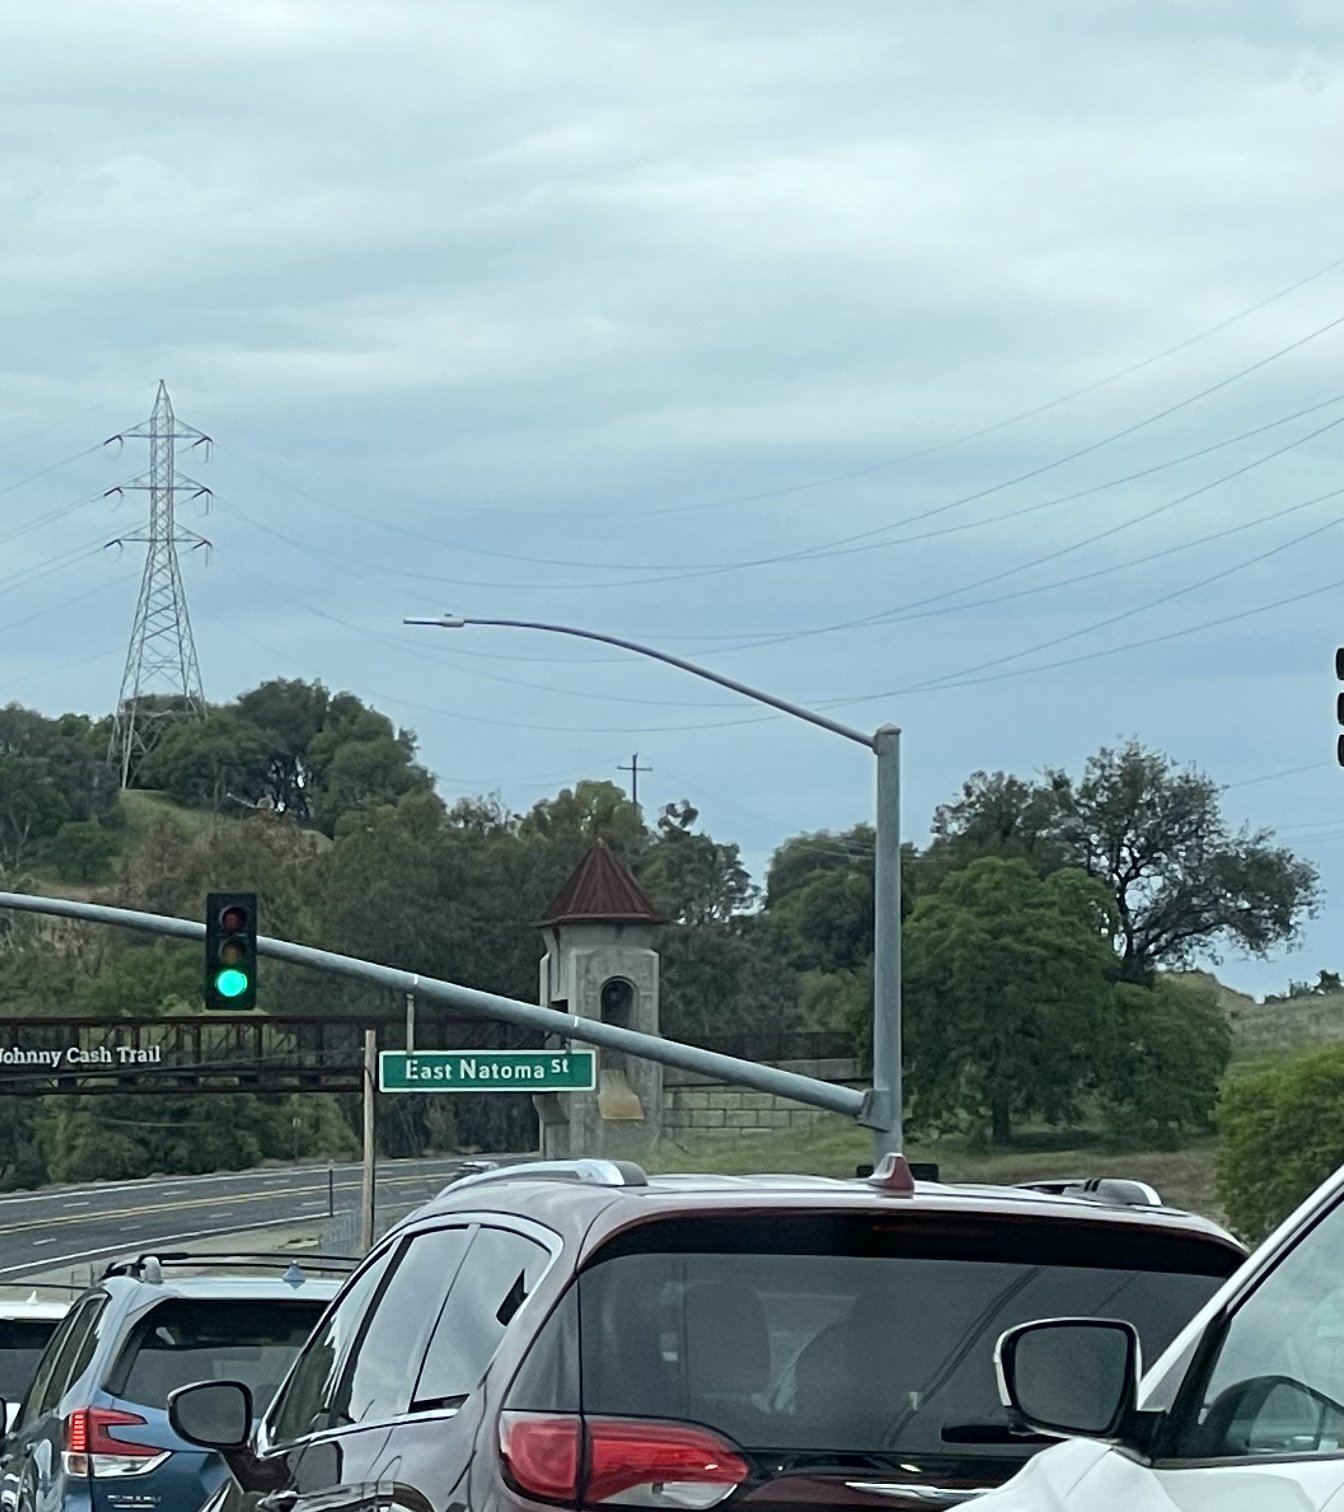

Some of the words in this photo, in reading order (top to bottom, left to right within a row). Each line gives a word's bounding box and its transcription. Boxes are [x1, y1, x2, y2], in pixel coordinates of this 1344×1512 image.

[66, 1046, 113, 1064] Cash
[117, 1045, 161, 1063] Trail
[405, 1059, 453, 1080] East
[459, 1058, 546, 1080] Natoma
[551, 1059, 570, 1074] St
